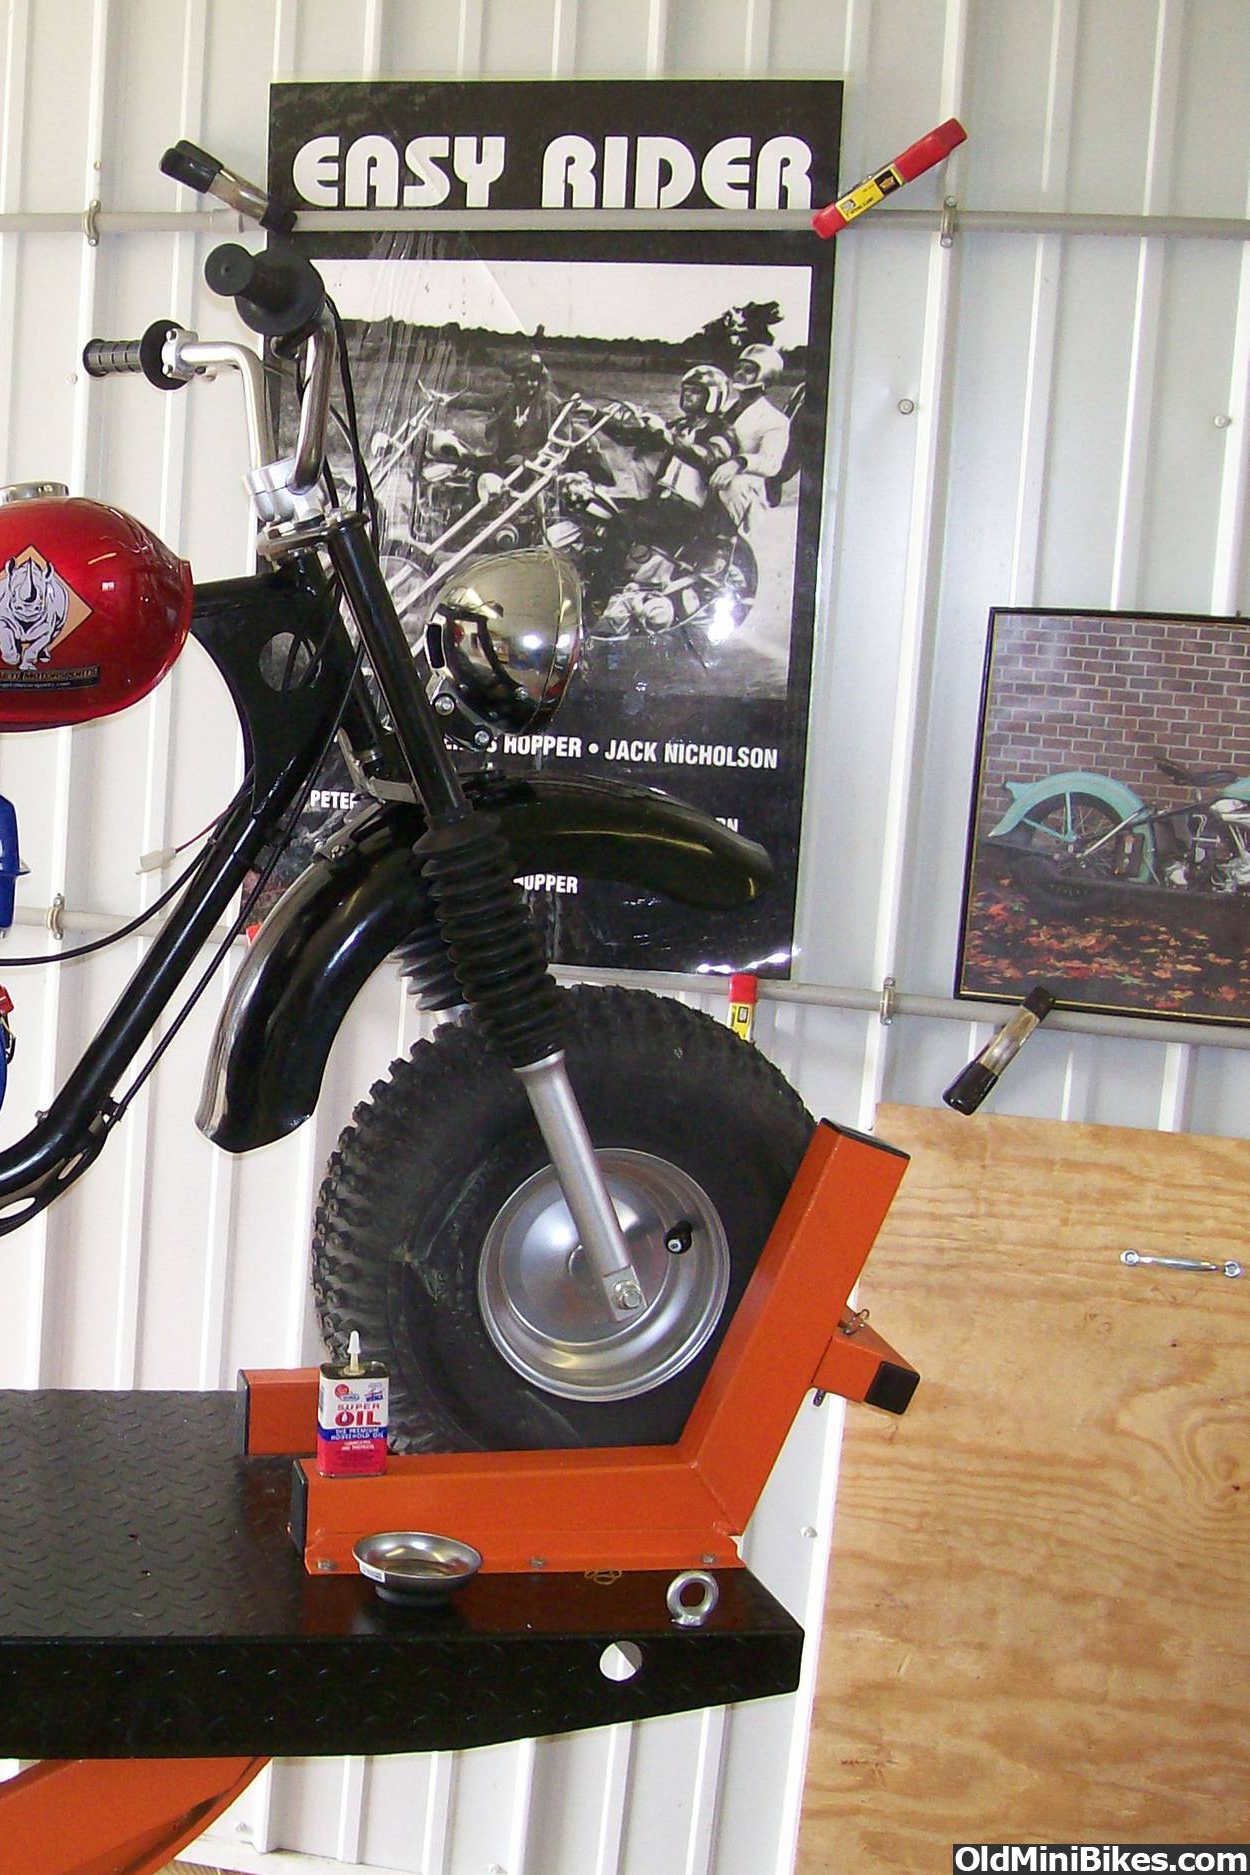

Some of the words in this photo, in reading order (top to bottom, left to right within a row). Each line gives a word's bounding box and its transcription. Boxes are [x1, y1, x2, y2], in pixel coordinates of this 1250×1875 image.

[292, 134, 505, 208] EASY
[541, 134, 813, 211] RIDER
[503, 733, 582, 758] HOPPER
[604, 739, 657, 763] JACK
[663, 742, 778, 769] NICHOLSON
[513, 873, 578, 894] OPPER
[337, 1403, 380, 1411] SUPER
[335, 1411, 382, 1427] OIL
